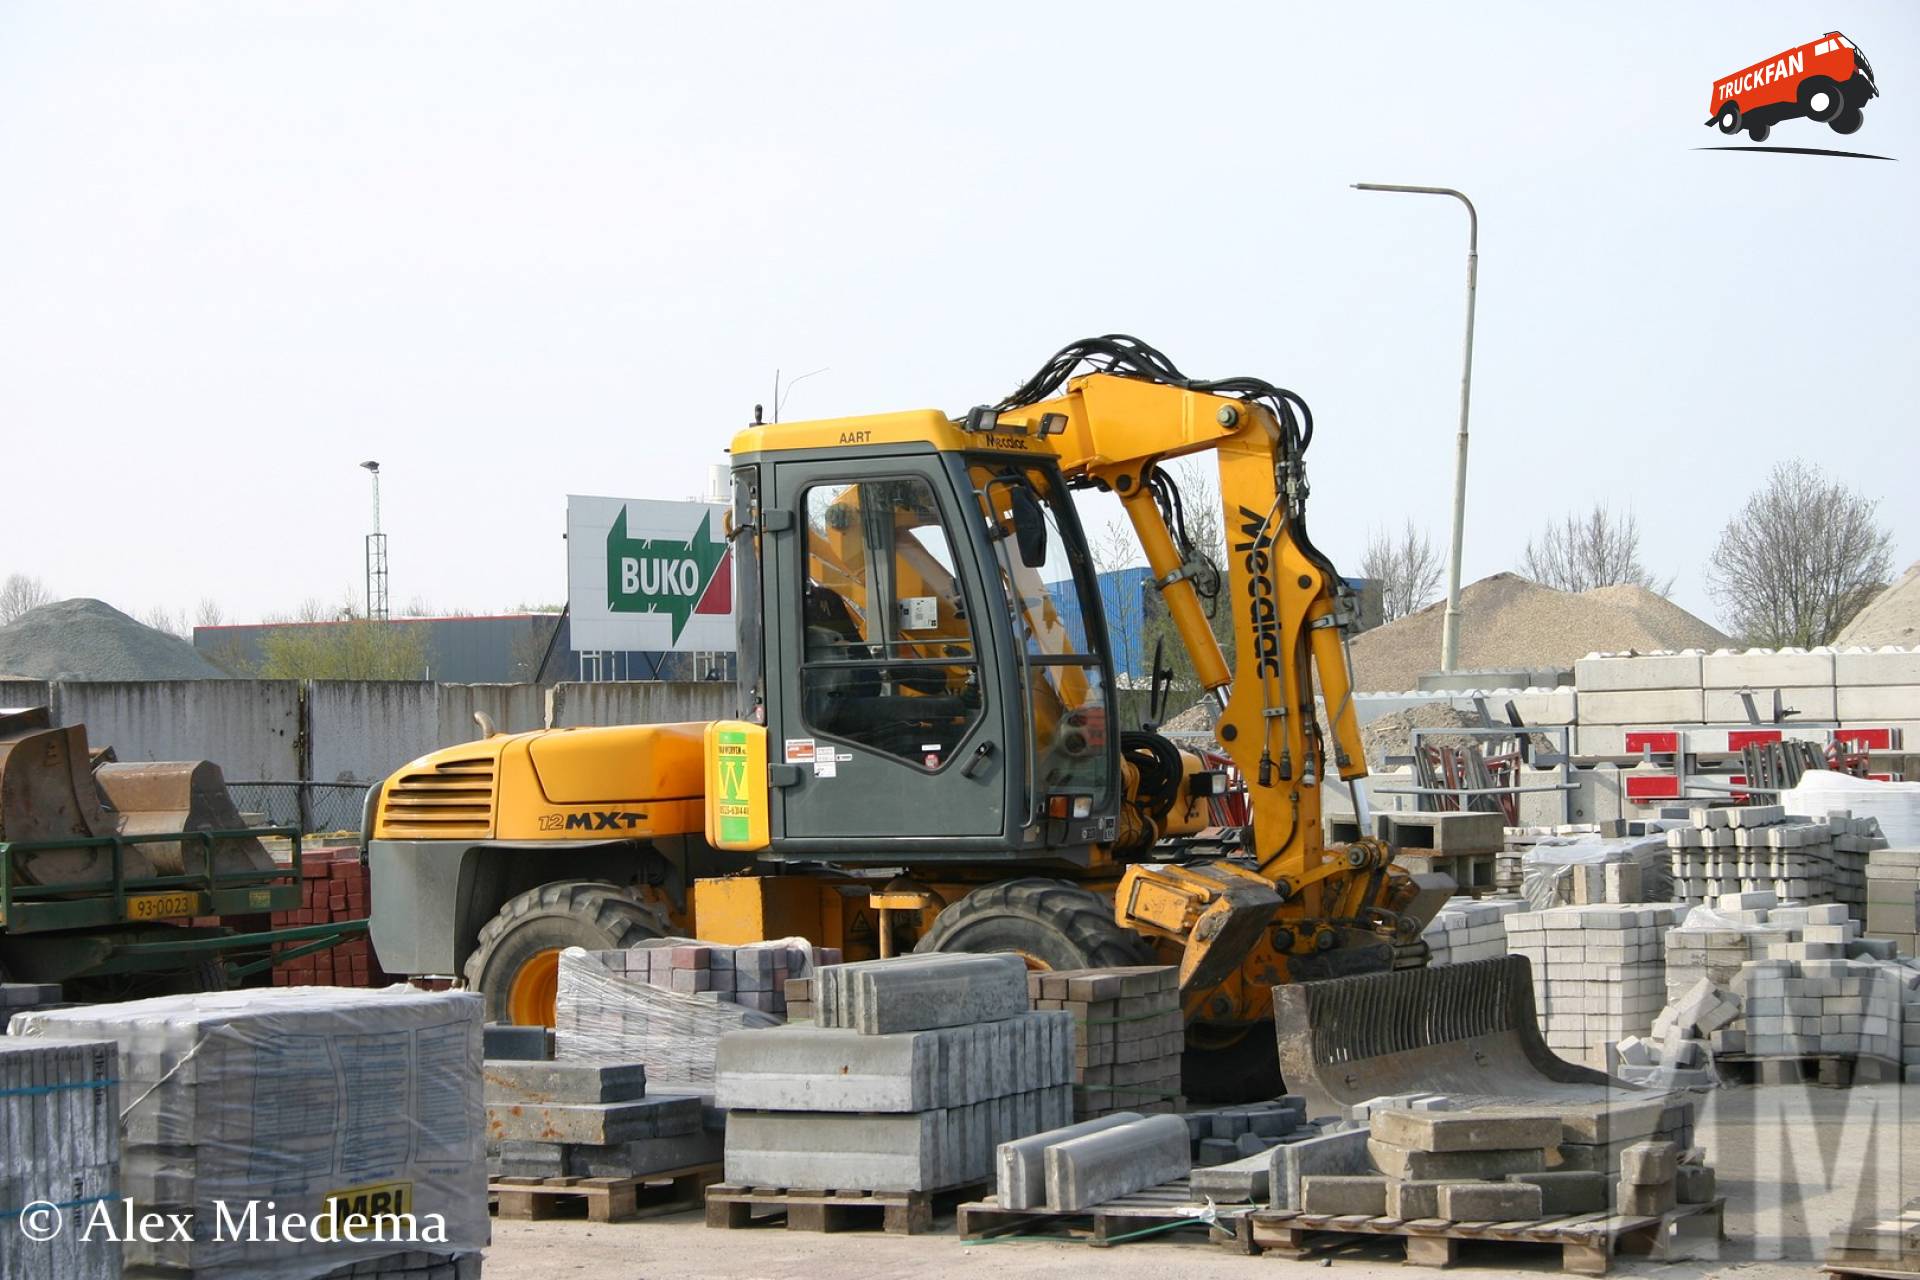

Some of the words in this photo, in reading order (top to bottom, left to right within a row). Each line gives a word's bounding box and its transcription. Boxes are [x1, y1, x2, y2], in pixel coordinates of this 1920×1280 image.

[839, 431, 872, 445] AART
[621, 557, 699, 596] BUKO
[1235, 505, 1282, 679] Mecalac
